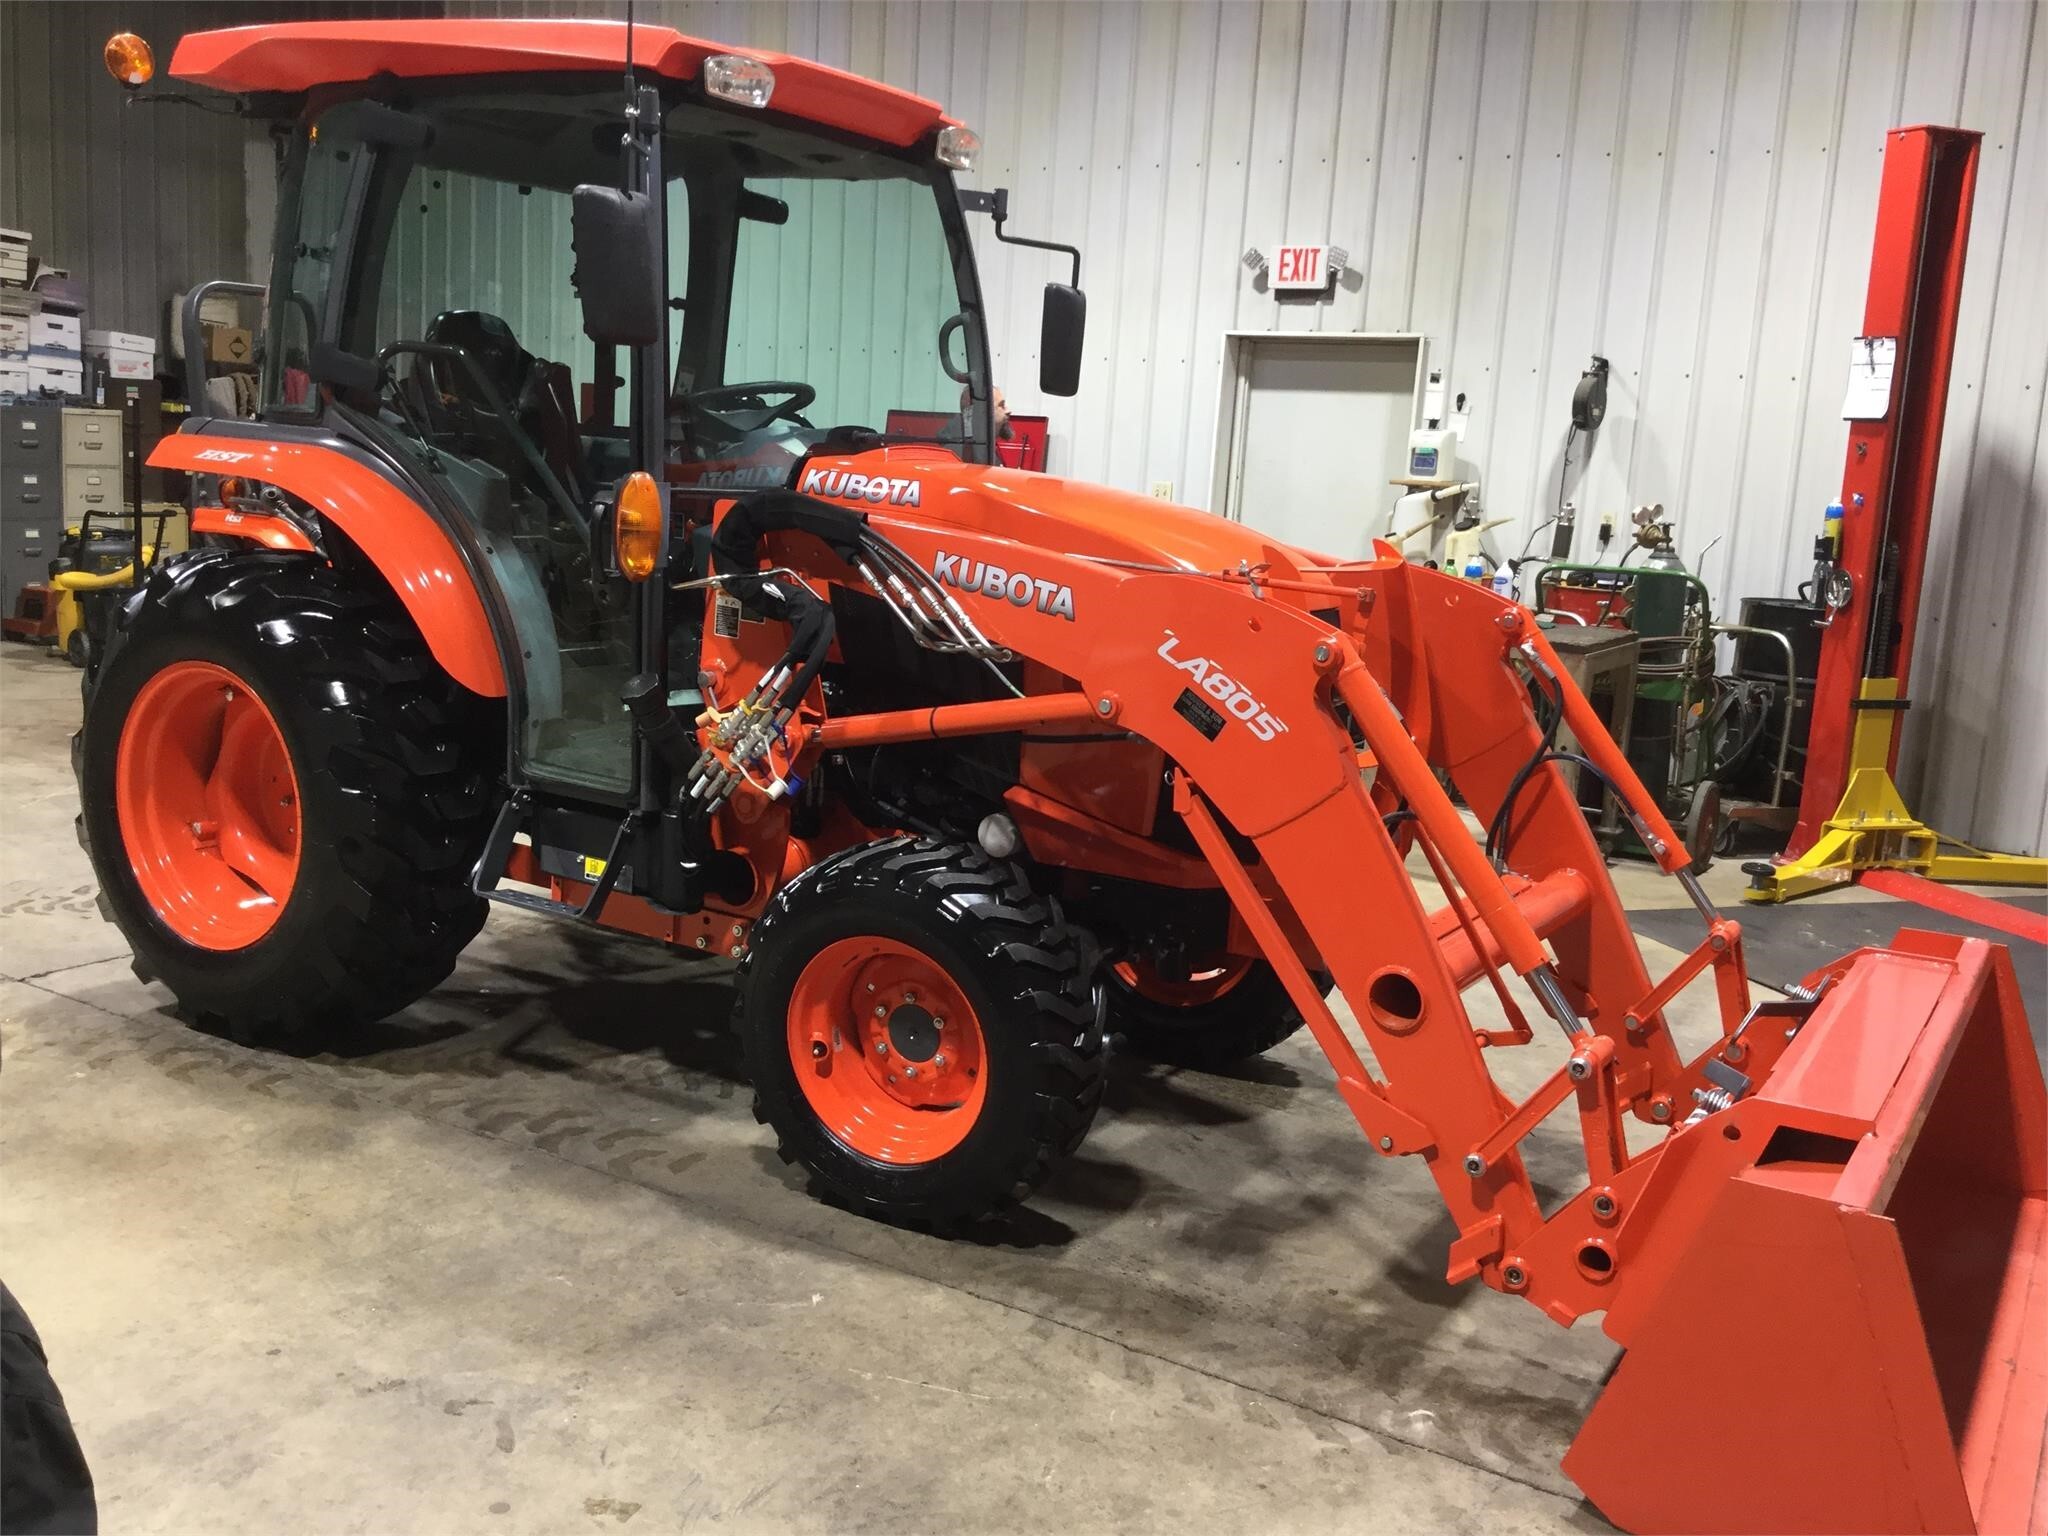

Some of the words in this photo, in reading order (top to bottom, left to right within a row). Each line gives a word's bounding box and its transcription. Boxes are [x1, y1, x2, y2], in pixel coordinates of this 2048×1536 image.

[1279, 248, 1321, 282] EXIT
[802, 467, 921, 508] KUBOTA
[933, 550, 1075, 622] KUBOTA
[1157, 629, 1289, 741] LA805
